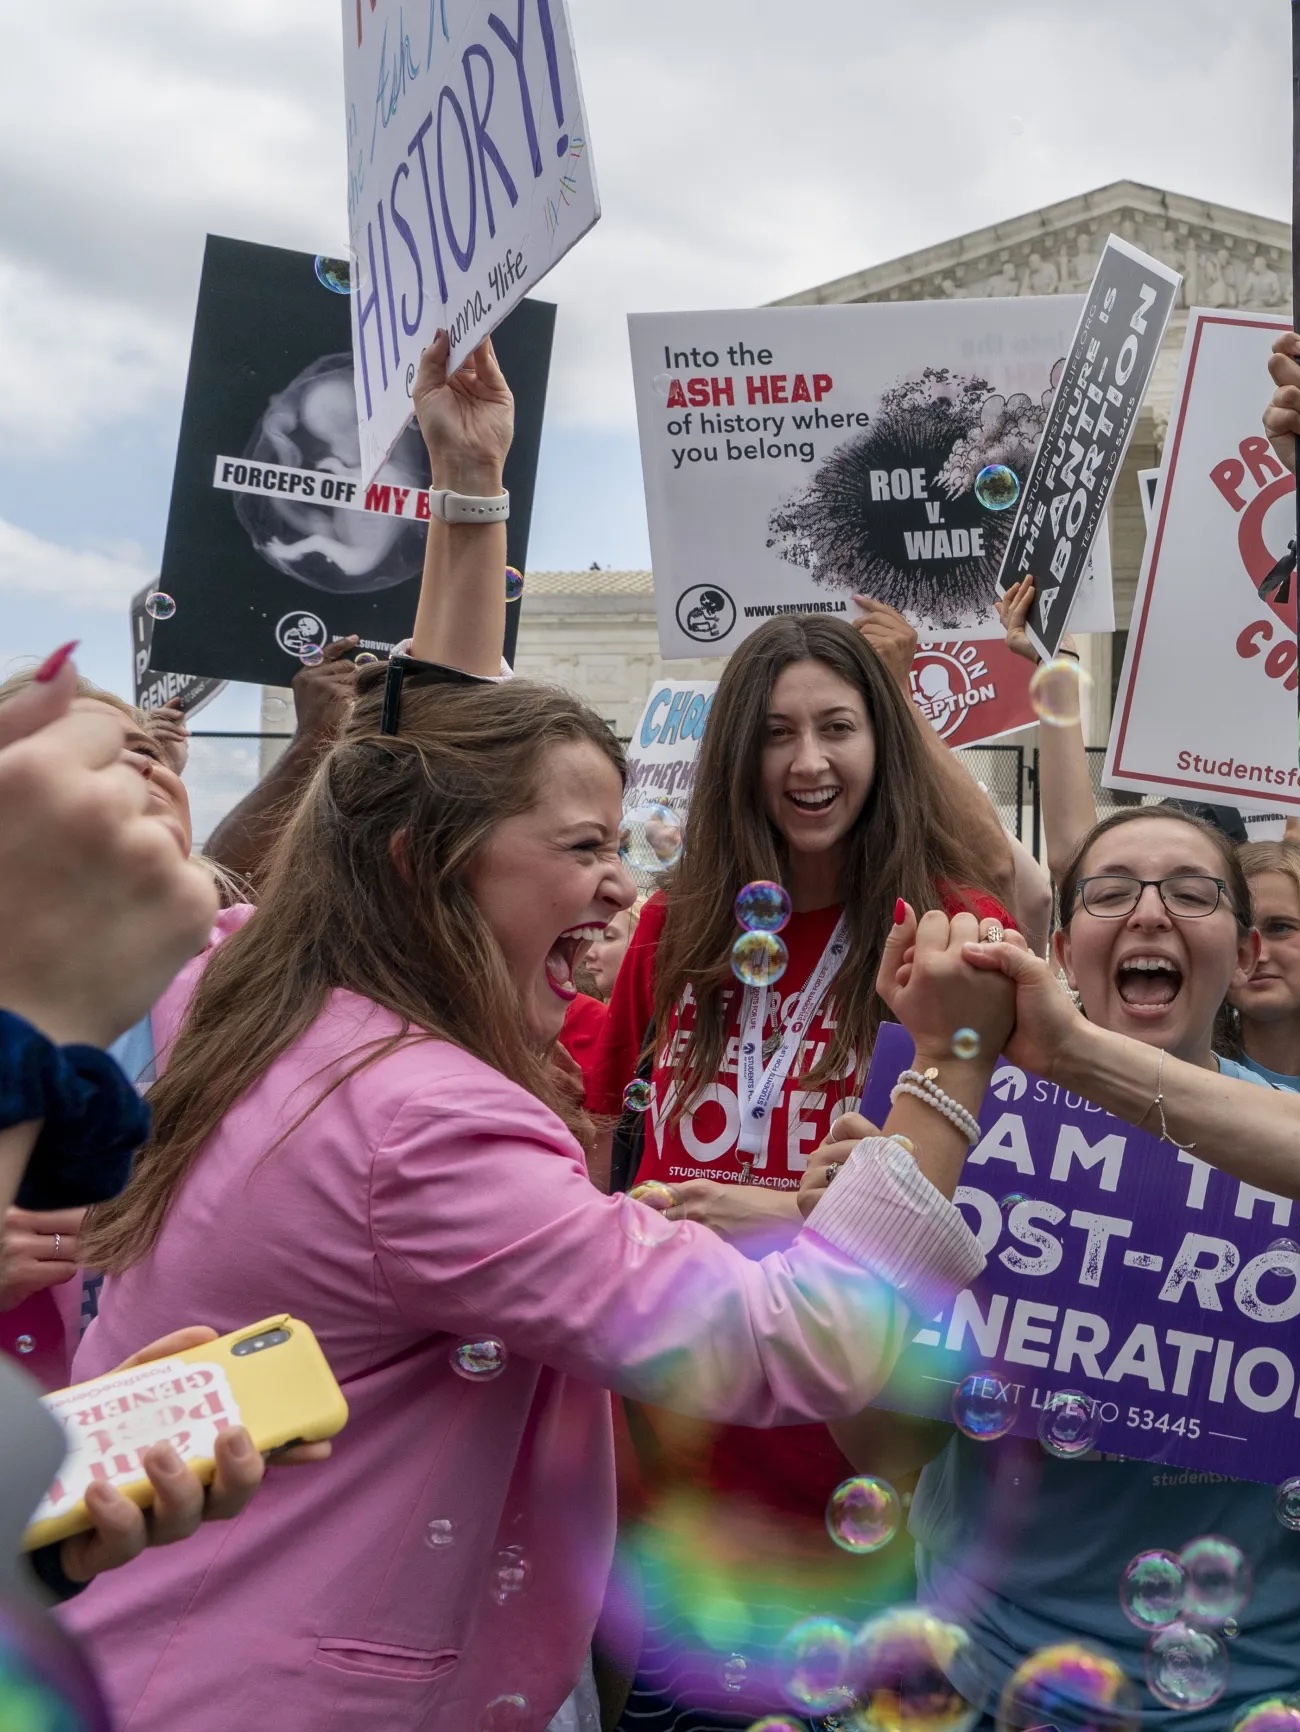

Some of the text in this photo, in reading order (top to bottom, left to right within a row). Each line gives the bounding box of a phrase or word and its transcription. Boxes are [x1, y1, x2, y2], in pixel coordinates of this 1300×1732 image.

[356, 0, 570, 421] HISTORY!
[664, 341, 773, 369] Into the
[666, 373, 833, 408] ASH HEAP
[1027, 303, 1097, 512] STUDENTSFORLIFE.ORG
[667, 407, 869, 437] of history where
[1018, 286, 1117, 571] THE FUTURE IS
[1050, 356, 1109, 540] ANTI-
[671, 437, 815, 469] you belong
[1039, 283, 1157, 634] ABORTION
[1081, 396, 1136, 548] TEXT LIFE TO 53445
[221, 462, 315, 497] FORCEPS
[320, 478, 357, 503] OFF
[364, 482, 411, 516] MY
[869, 467, 928, 501] ROE
[925, 501, 945, 524] V.
[903, 527, 986, 561] WADE
[757, 1071, 776, 1106] STUDENTS
[967, 1112, 1127, 1191] AM
[969, 1375, 1201, 1439] TEXT LIFE TO 53445
